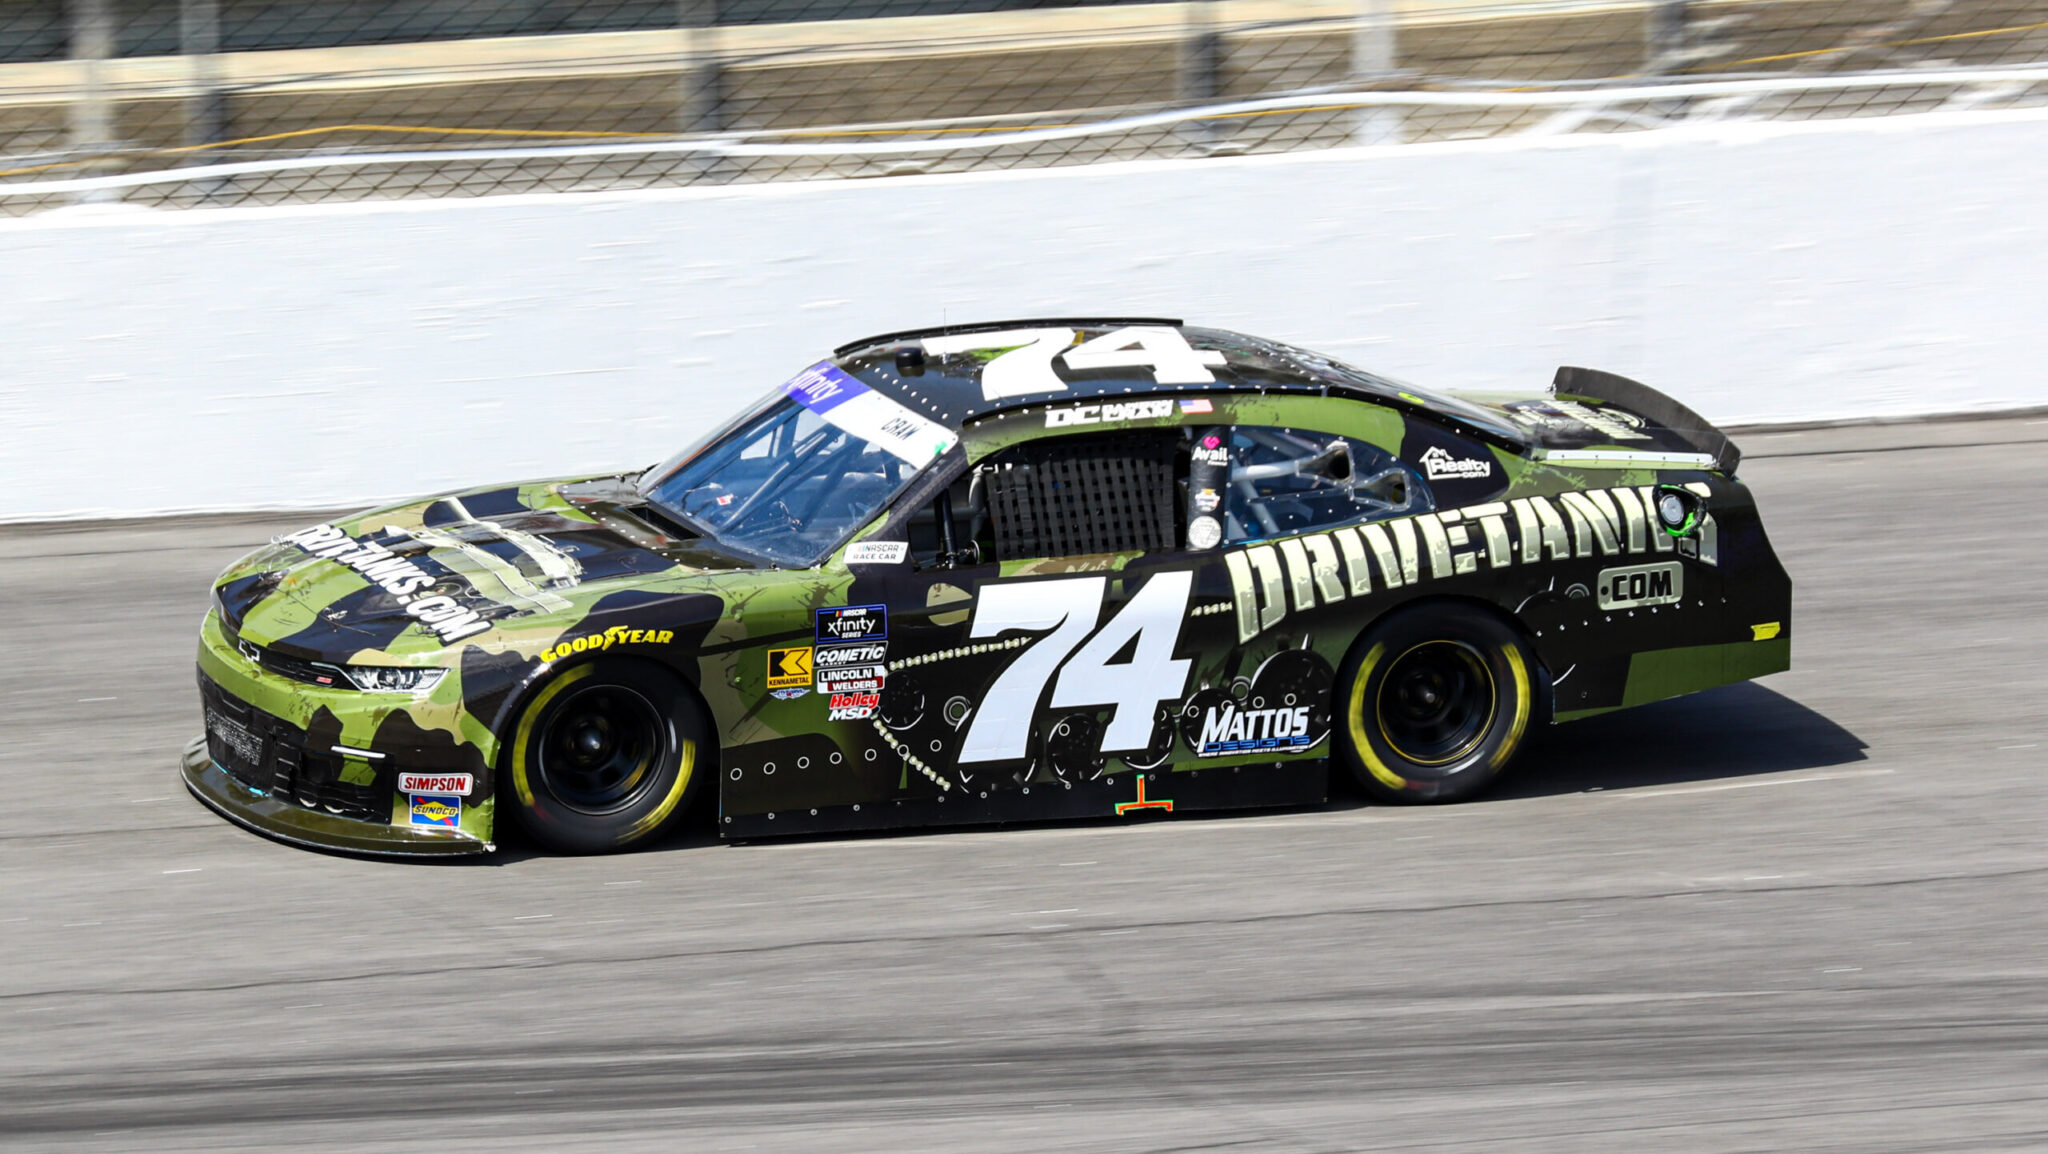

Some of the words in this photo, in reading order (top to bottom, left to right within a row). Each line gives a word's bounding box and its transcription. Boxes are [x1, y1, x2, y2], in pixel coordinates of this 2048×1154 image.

[920, 327, 1228, 401] 74
[1192, 446, 1228, 460] Avail
[1430, 458, 1490, 476] Realty
[282, 524, 492, 642] DRITANKS.COM
[828, 617, 876, 636] xfinity
[540, 625, 674, 662] GOODYEAR
[816, 646, 885, 664] COMETIC
[821, 669, 873, 681] LINCOLN
[957, 570, 1193, 764] 74
[769, 676, 810, 687] KENNAMETAL
[832, 680, 878, 691] WELDERS
[829, 692, 880, 709] Holley
[828, 706, 873, 721] MSD
[404, 776, 466, 791] SIMPSON
[415, 805, 457, 816] SUNOCO
